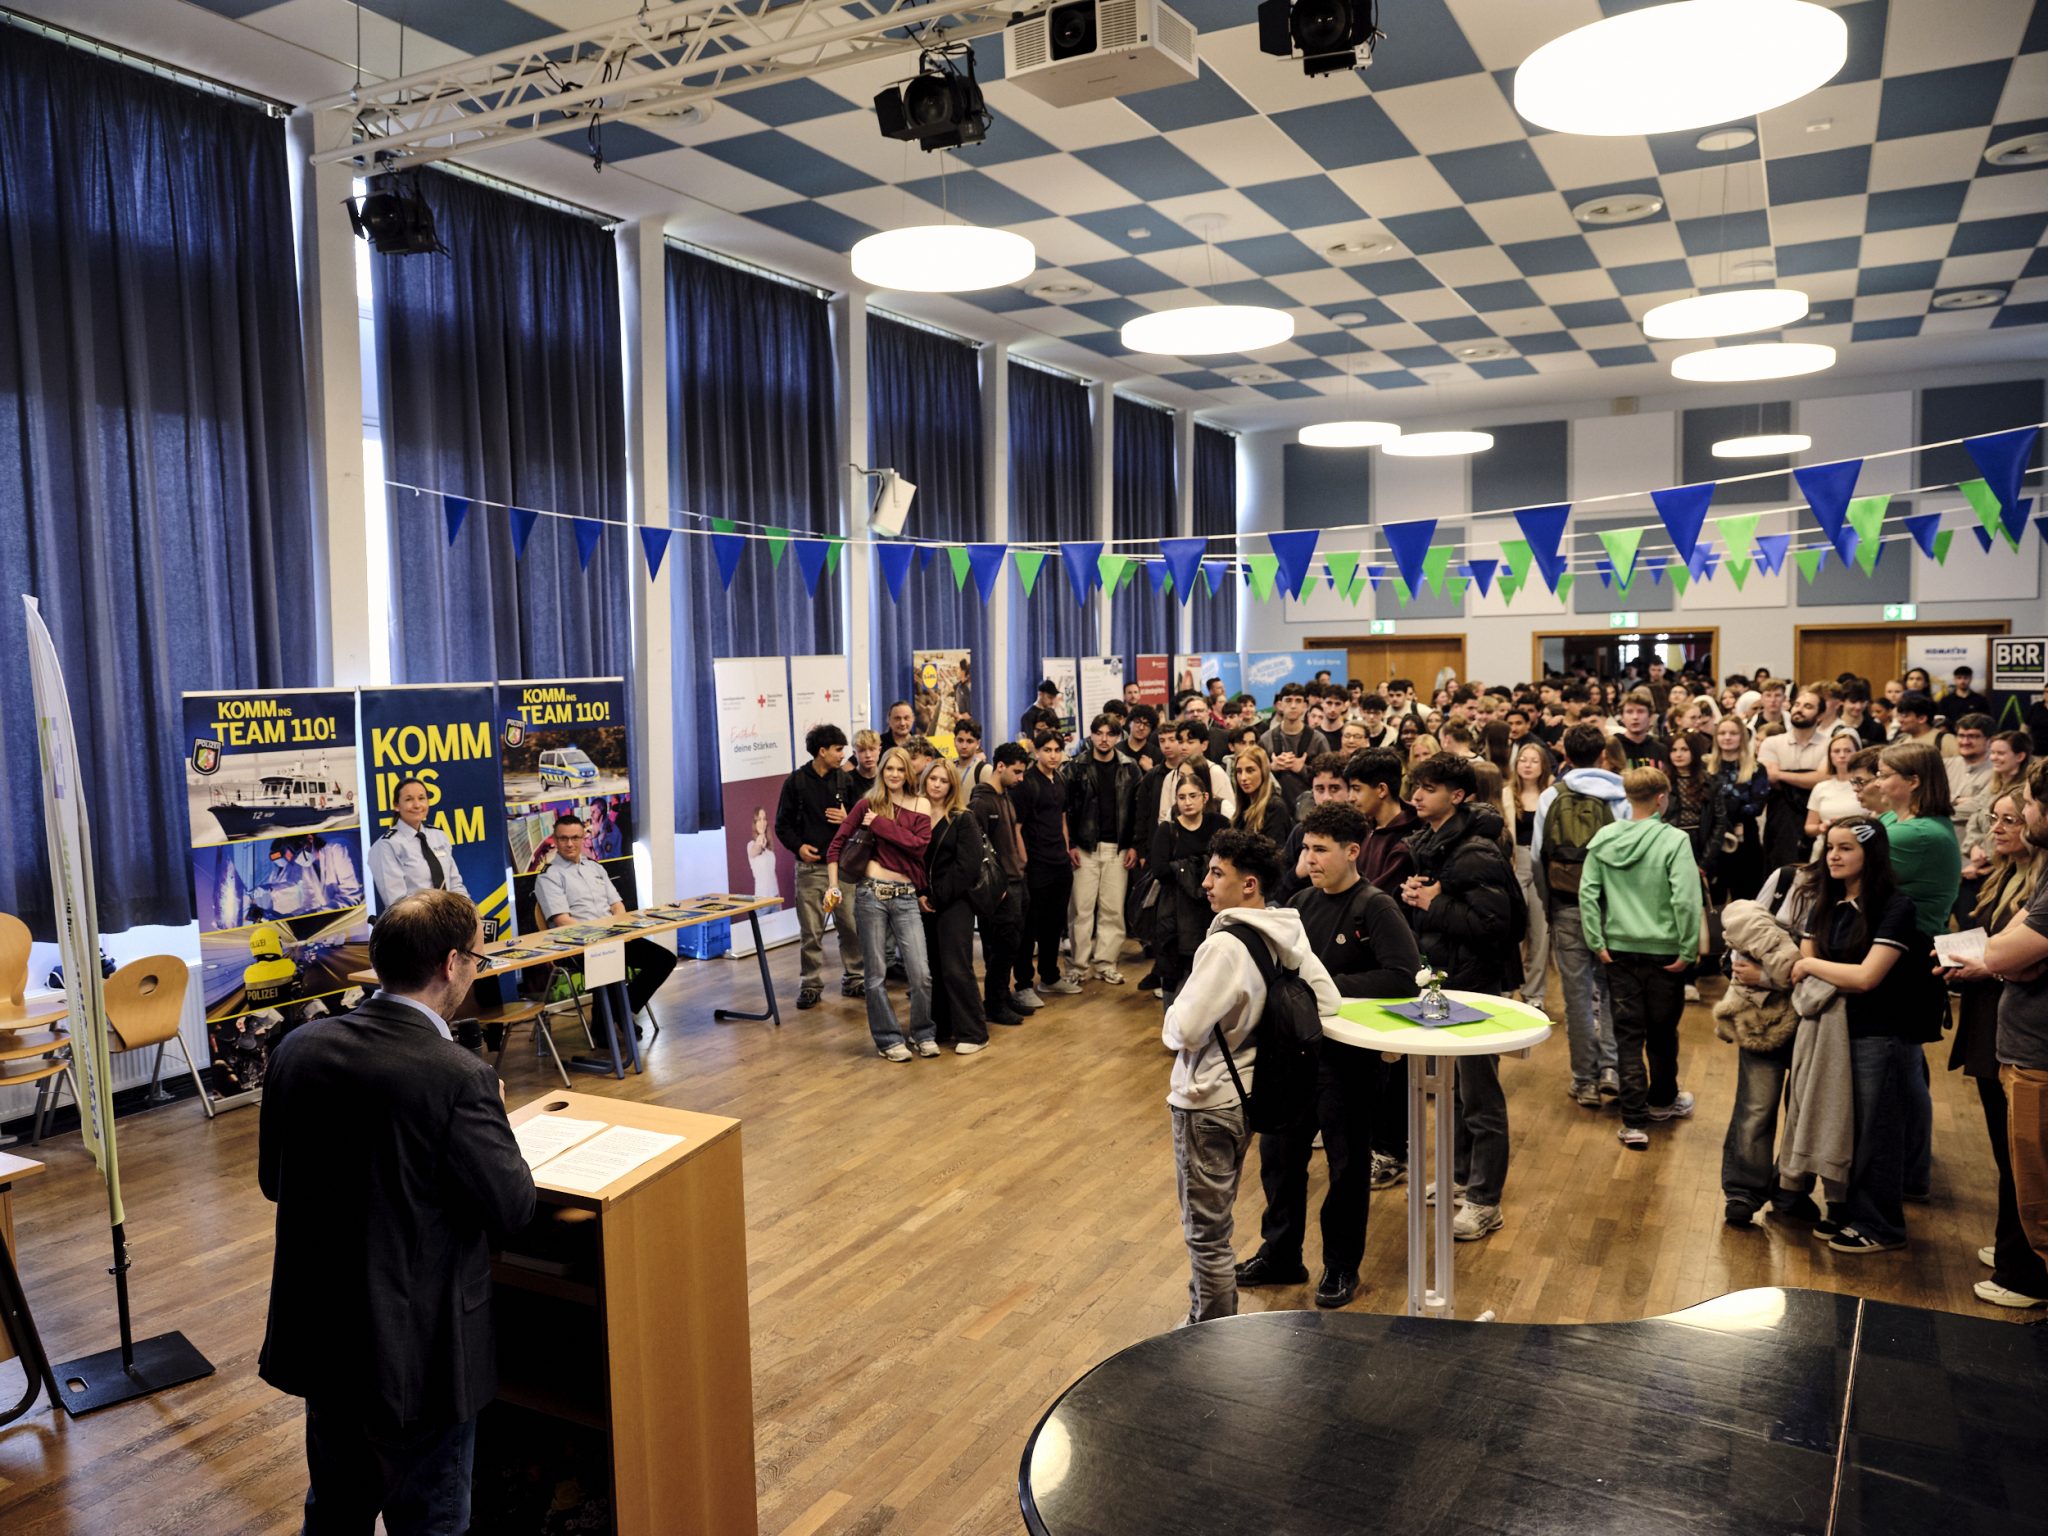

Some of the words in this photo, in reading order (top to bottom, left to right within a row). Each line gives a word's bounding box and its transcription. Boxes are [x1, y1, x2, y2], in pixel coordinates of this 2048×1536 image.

[523, 687, 566, 704] KOMM
[217, 699, 277, 719] KOMM
[278, 707, 292, 717] INS
[517, 703, 573, 725] TEAM
[575, 701, 611, 722] 110!
[210, 719, 286, 746] TEAM
[291, 717, 337, 742] 110!
[371, 721, 492, 768] KOMM
[378, 805, 486, 846] AM
[246, 987, 279, 1000] POLIZEI
